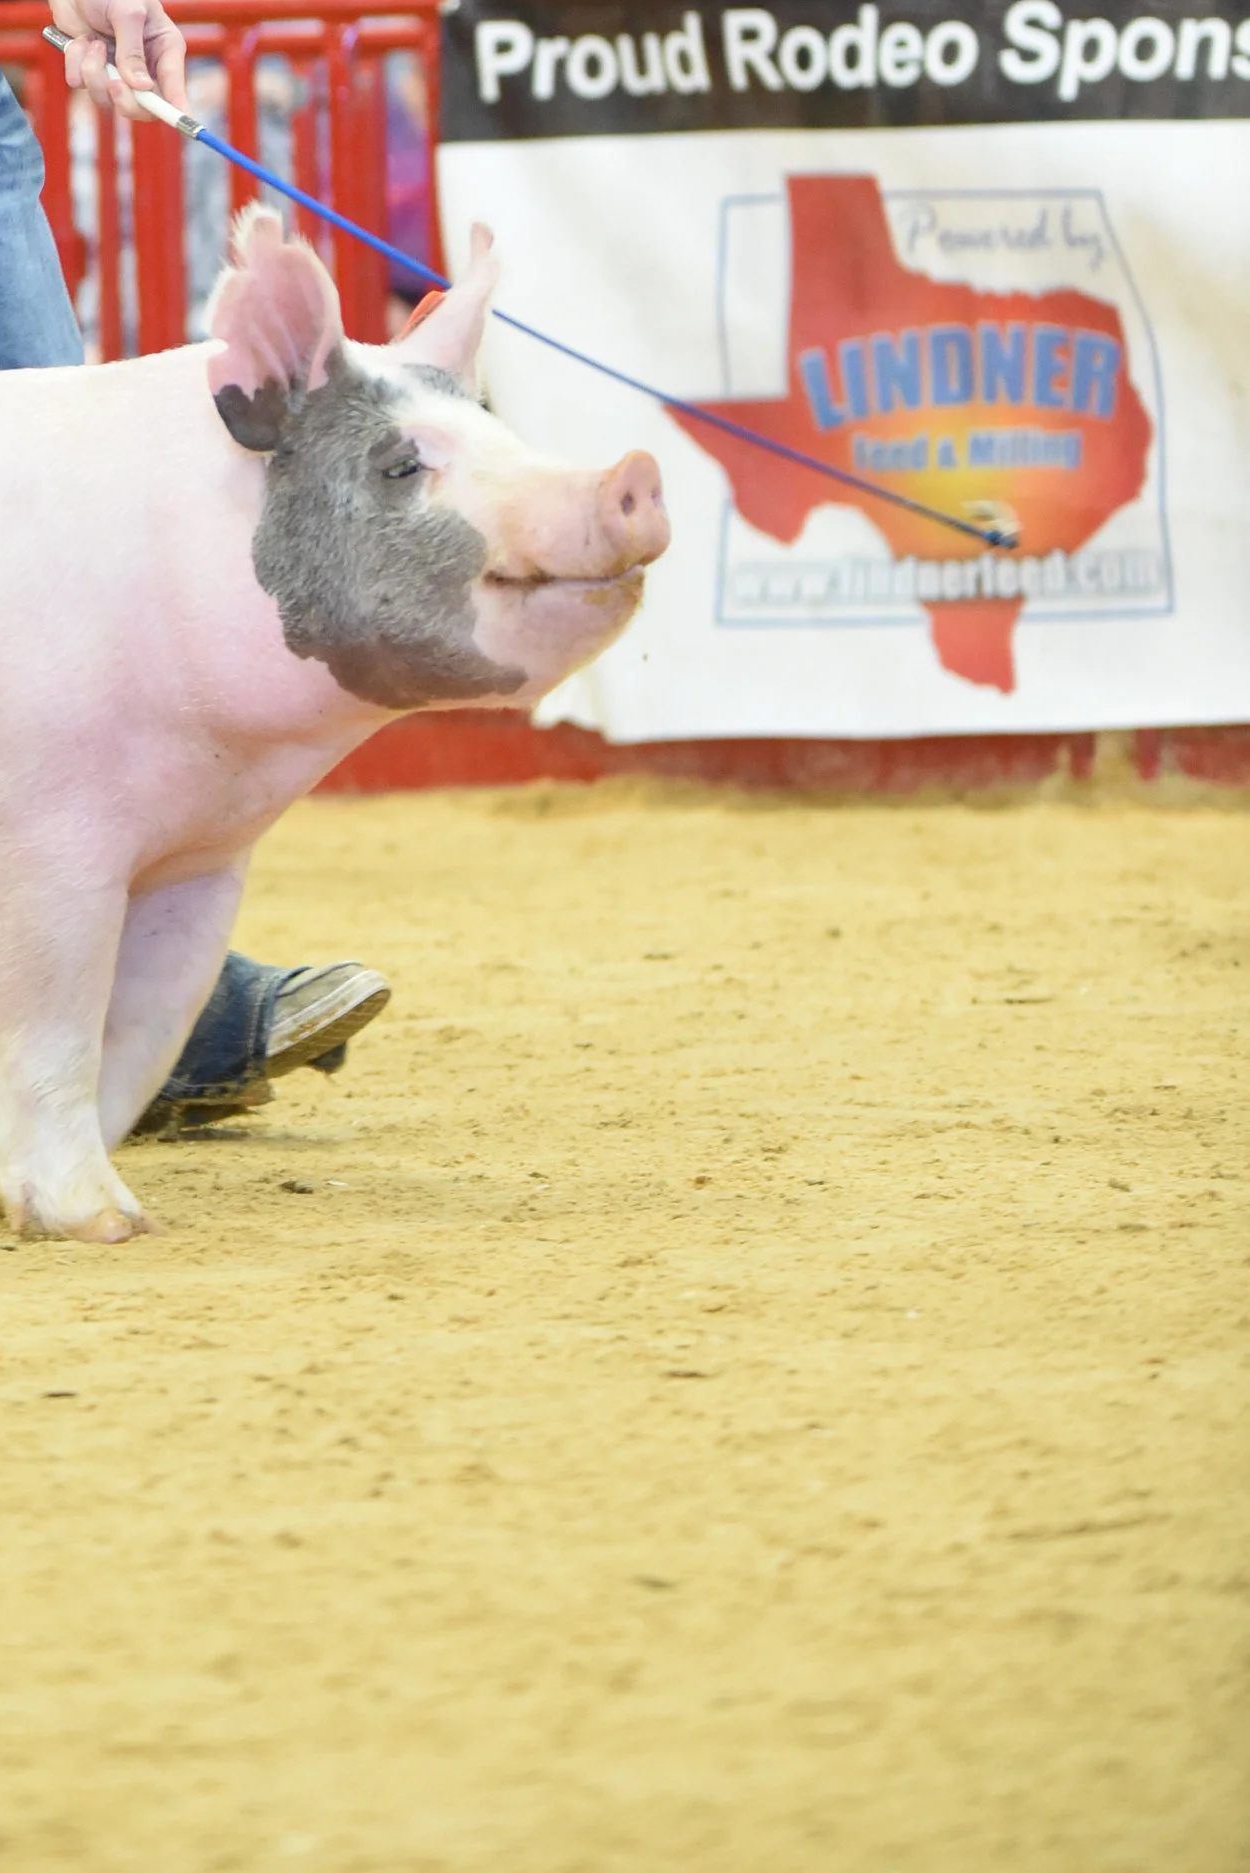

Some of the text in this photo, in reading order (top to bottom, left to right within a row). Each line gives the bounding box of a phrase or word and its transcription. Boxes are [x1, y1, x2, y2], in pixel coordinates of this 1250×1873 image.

[474, 11, 711, 104] Proud
[722, 4, 979, 92] Rodeo
[1061, 200, 1104, 273] by
[798, 321, 1122, 432] LINDNER
[937, 435, 958, 470] &
[968, 427, 1083, 472] Milling
